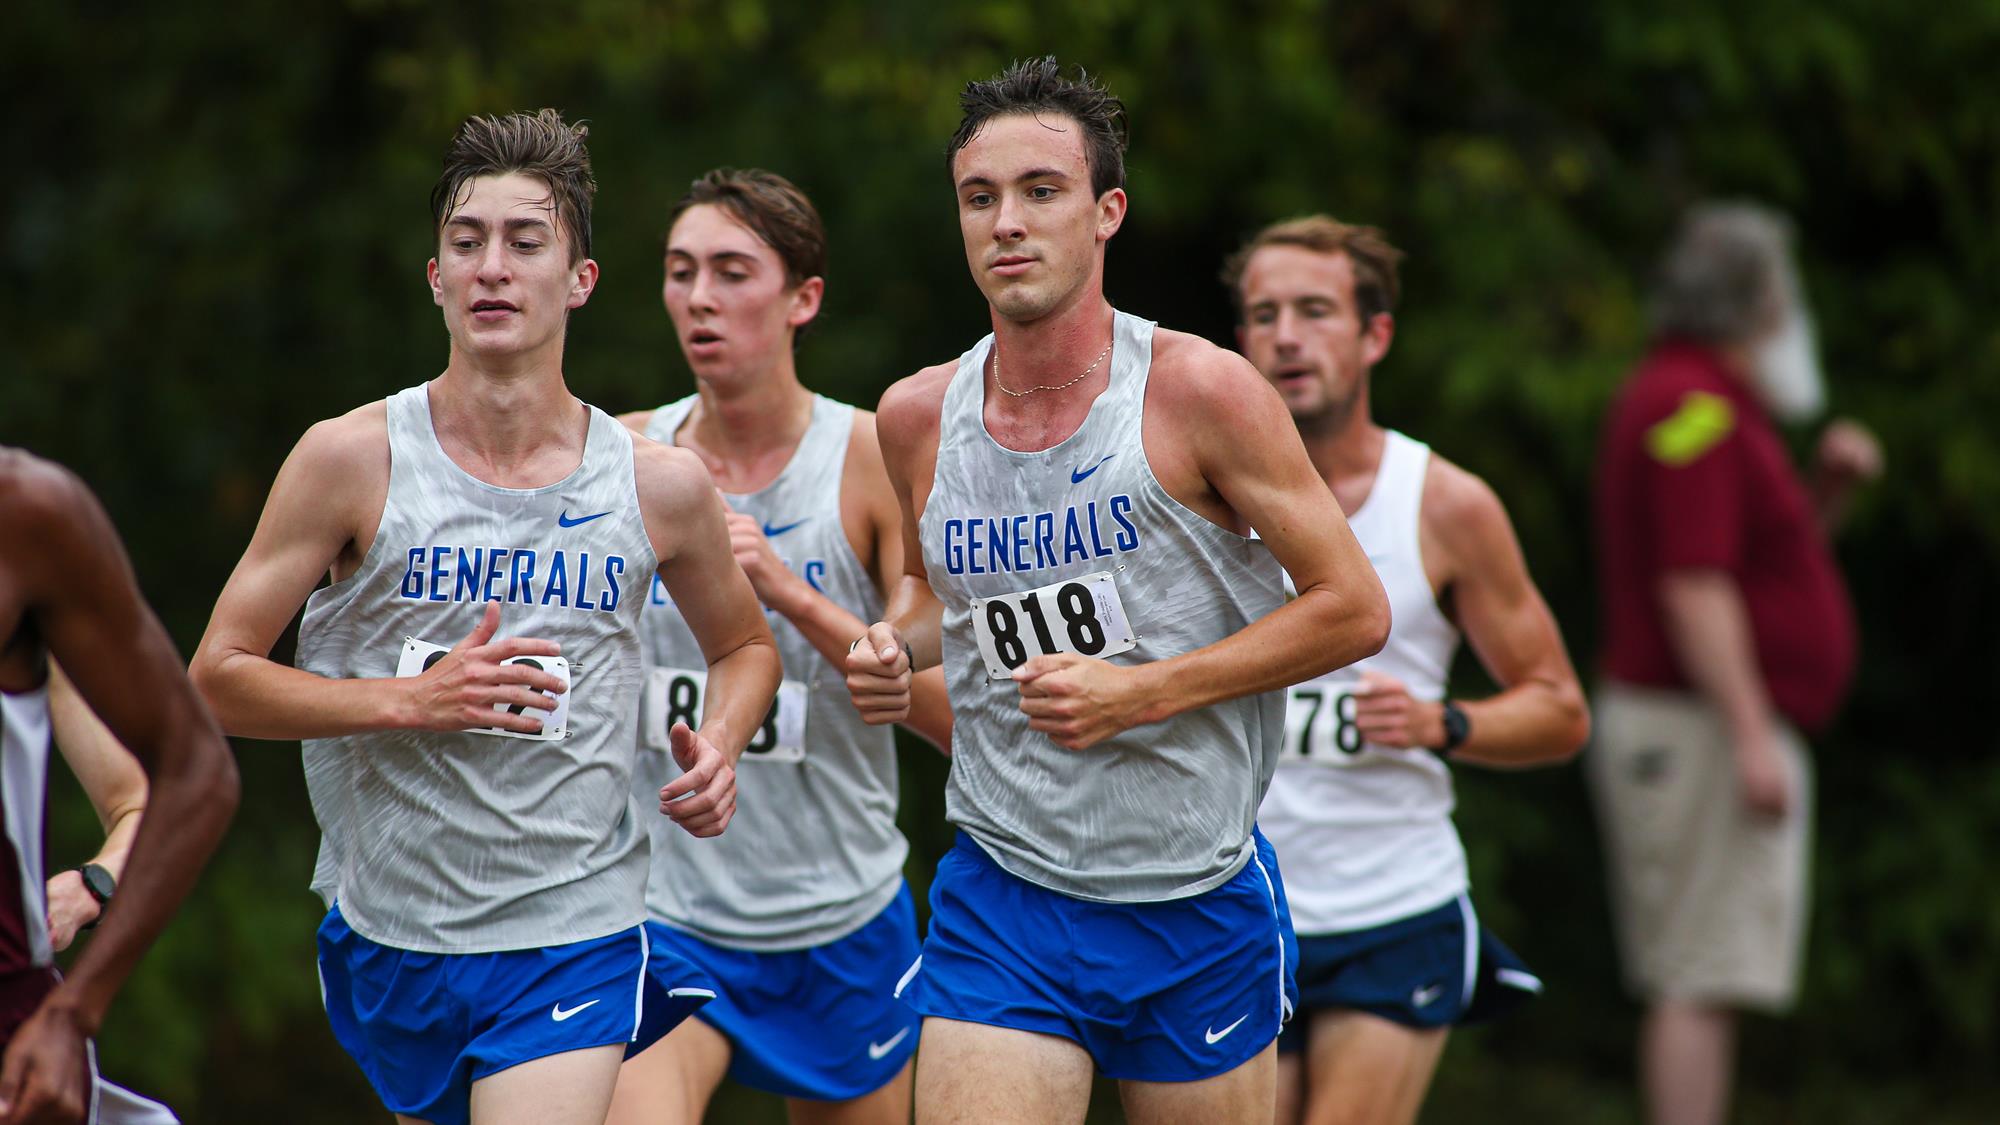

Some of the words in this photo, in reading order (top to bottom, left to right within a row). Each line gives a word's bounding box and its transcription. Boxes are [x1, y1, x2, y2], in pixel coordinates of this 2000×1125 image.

[944, 494, 1138, 575] GENERALS
[402, 546, 624, 613] GENERALS
[986, 582, 1107, 670] 818
[1281, 692, 1364, 755] 78
